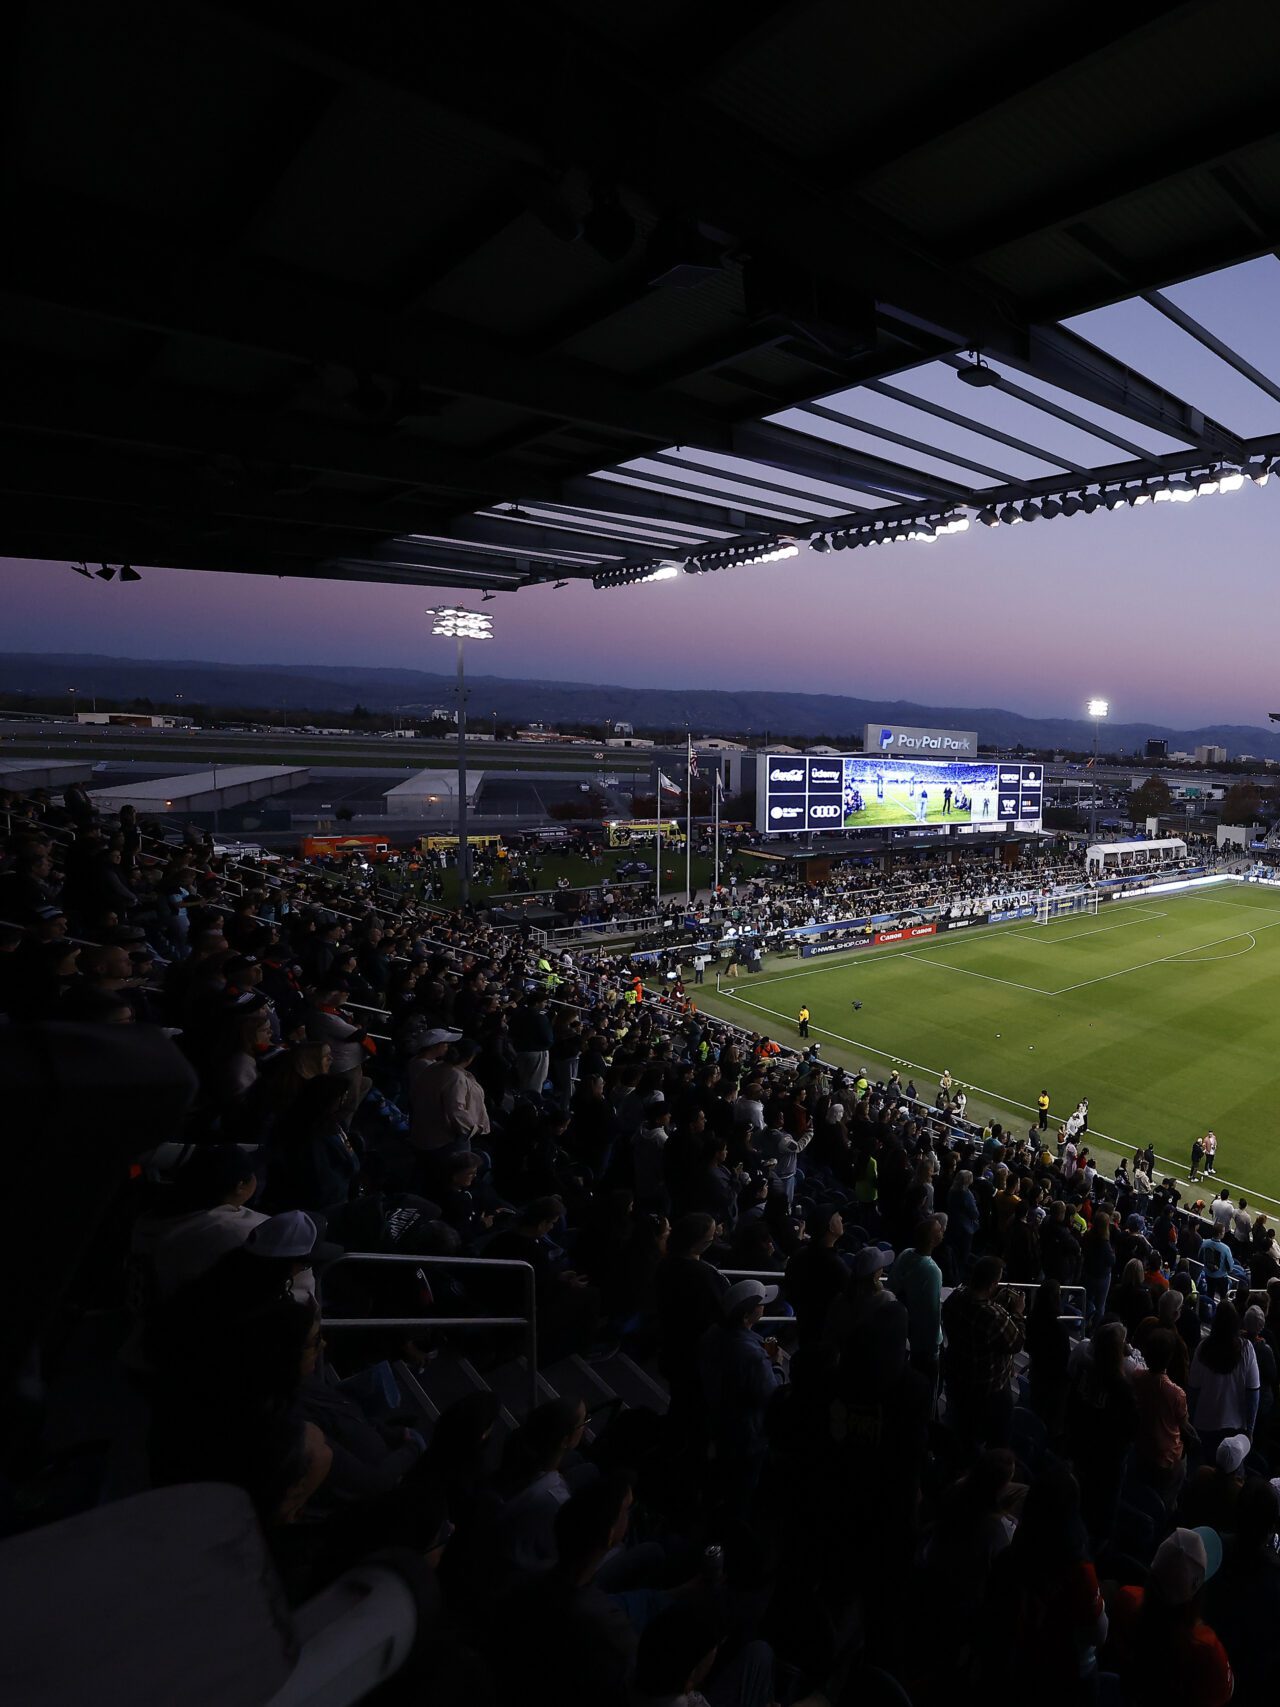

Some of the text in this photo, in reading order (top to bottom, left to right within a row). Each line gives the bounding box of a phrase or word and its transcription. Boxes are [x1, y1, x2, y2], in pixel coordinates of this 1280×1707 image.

[898, 734, 970, 750] PayPal Park
[912, 927, 932, 936] Canon
[880, 933, 902, 942] Canon
